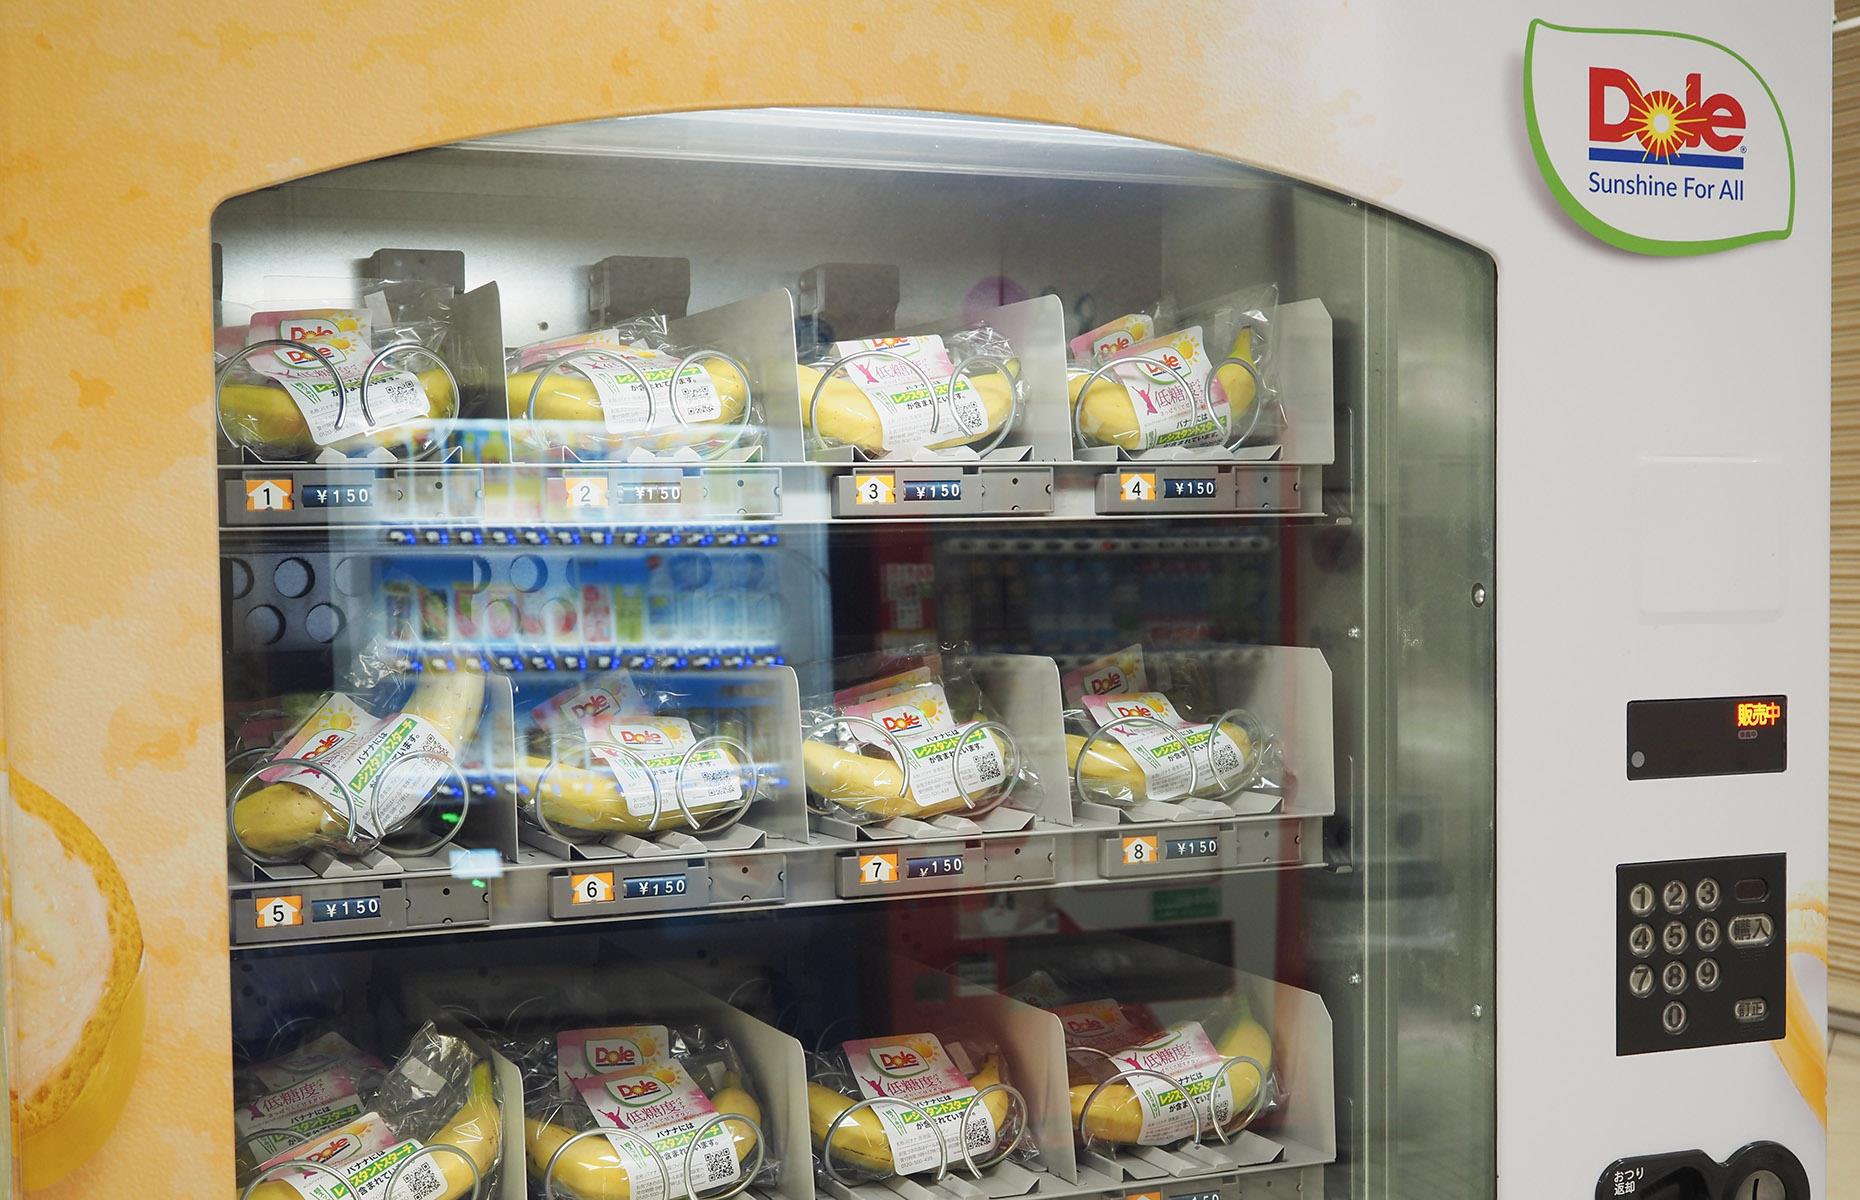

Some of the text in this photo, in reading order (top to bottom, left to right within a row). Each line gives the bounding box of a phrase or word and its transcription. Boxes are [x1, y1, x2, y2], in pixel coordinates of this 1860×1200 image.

[1589, 66, 1746, 158] Dole
[1588, 171, 1744, 201] Sunshine For All
[262, 487, 272, 506] 1
[317, 487, 369, 504] ¥150
[580, 485, 591, 502] 2
[635, 486, 681, 500] ¥150
[868, 484, 878, 499] 3
[917, 484, 960, 500] ¥150
[1132, 481, 1142, 496] 4
[1175, 481, 1214, 496] ¥150
[1091, 671, 1123, 694] Dole
[883, 711, 922, 732] Dole
[1117, 705, 1152, 719] Dole
[1737, 701, 1781, 727] 販売中
[620, 730, 662, 744] Dole
[350, 718, 414, 791] レジスタントスターチ
[356, 731, 388, 765] バナナには
[1134, 843, 1144, 859] 8
[1177, 840, 1217, 855] ¥150
[873, 862, 882, 878] 7
[587, 881, 598, 898] 6
[639, 878, 686, 896] ¥150
[1668, 884, 1682, 906] 2
[1701, 882, 1714, 904] 3
[1636, 887, 1646, 909] 1
[272, 904, 285, 923] 5
[326, 898, 379, 918] ¥150
[1634, 928, 1648, 950] 4
[1669, 925, 1682, 947] 5
[1701, 922, 1714, 944] 6
[1635, 968, 1648, 991] 7
[1668, 965, 1682, 987] 8
[1702, 960, 1715, 982] 9
[1668, 1005, 1682, 1027] 0
[595, 1045, 635, 1064] Dole
[880, 1051, 917, 1068] Dole
[617, 1078, 660, 1098] Dole
[1177, 1071, 1204, 1086] ナナには
[262, 1081, 320, 1112] 低糖度
[290, 1106, 331, 1124] バナナには
[626, 1099, 678, 1125] 低糖度
[656, 1122, 695, 1139] バナナには
[346, 1150, 387, 1175] バナナには
[1613, 1167, 1645, 1183] おつり
[1613, 1180, 1636, 1197] 返却
